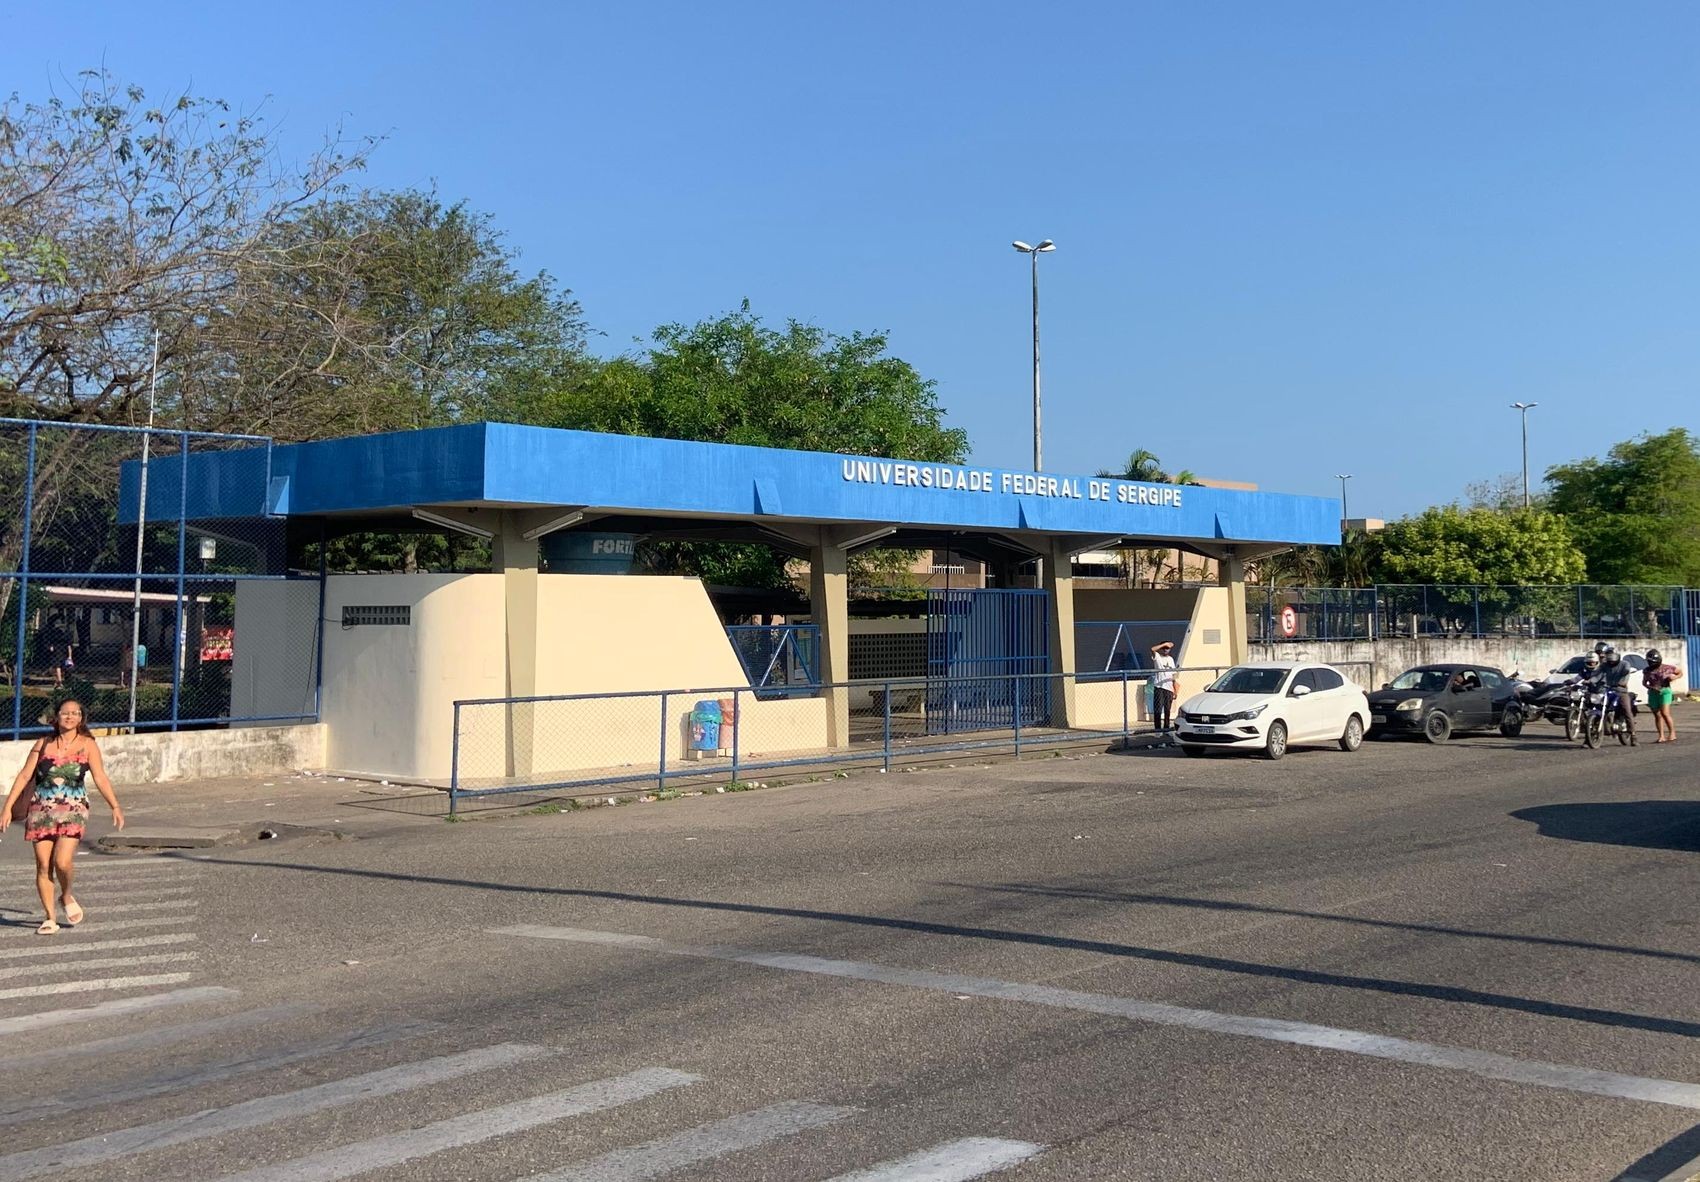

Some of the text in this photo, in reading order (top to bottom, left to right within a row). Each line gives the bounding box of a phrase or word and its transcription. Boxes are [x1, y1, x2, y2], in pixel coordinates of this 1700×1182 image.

[843, 459, 1182, 507] UNIVERSIDADE FEDERAL DE SERGIPE
